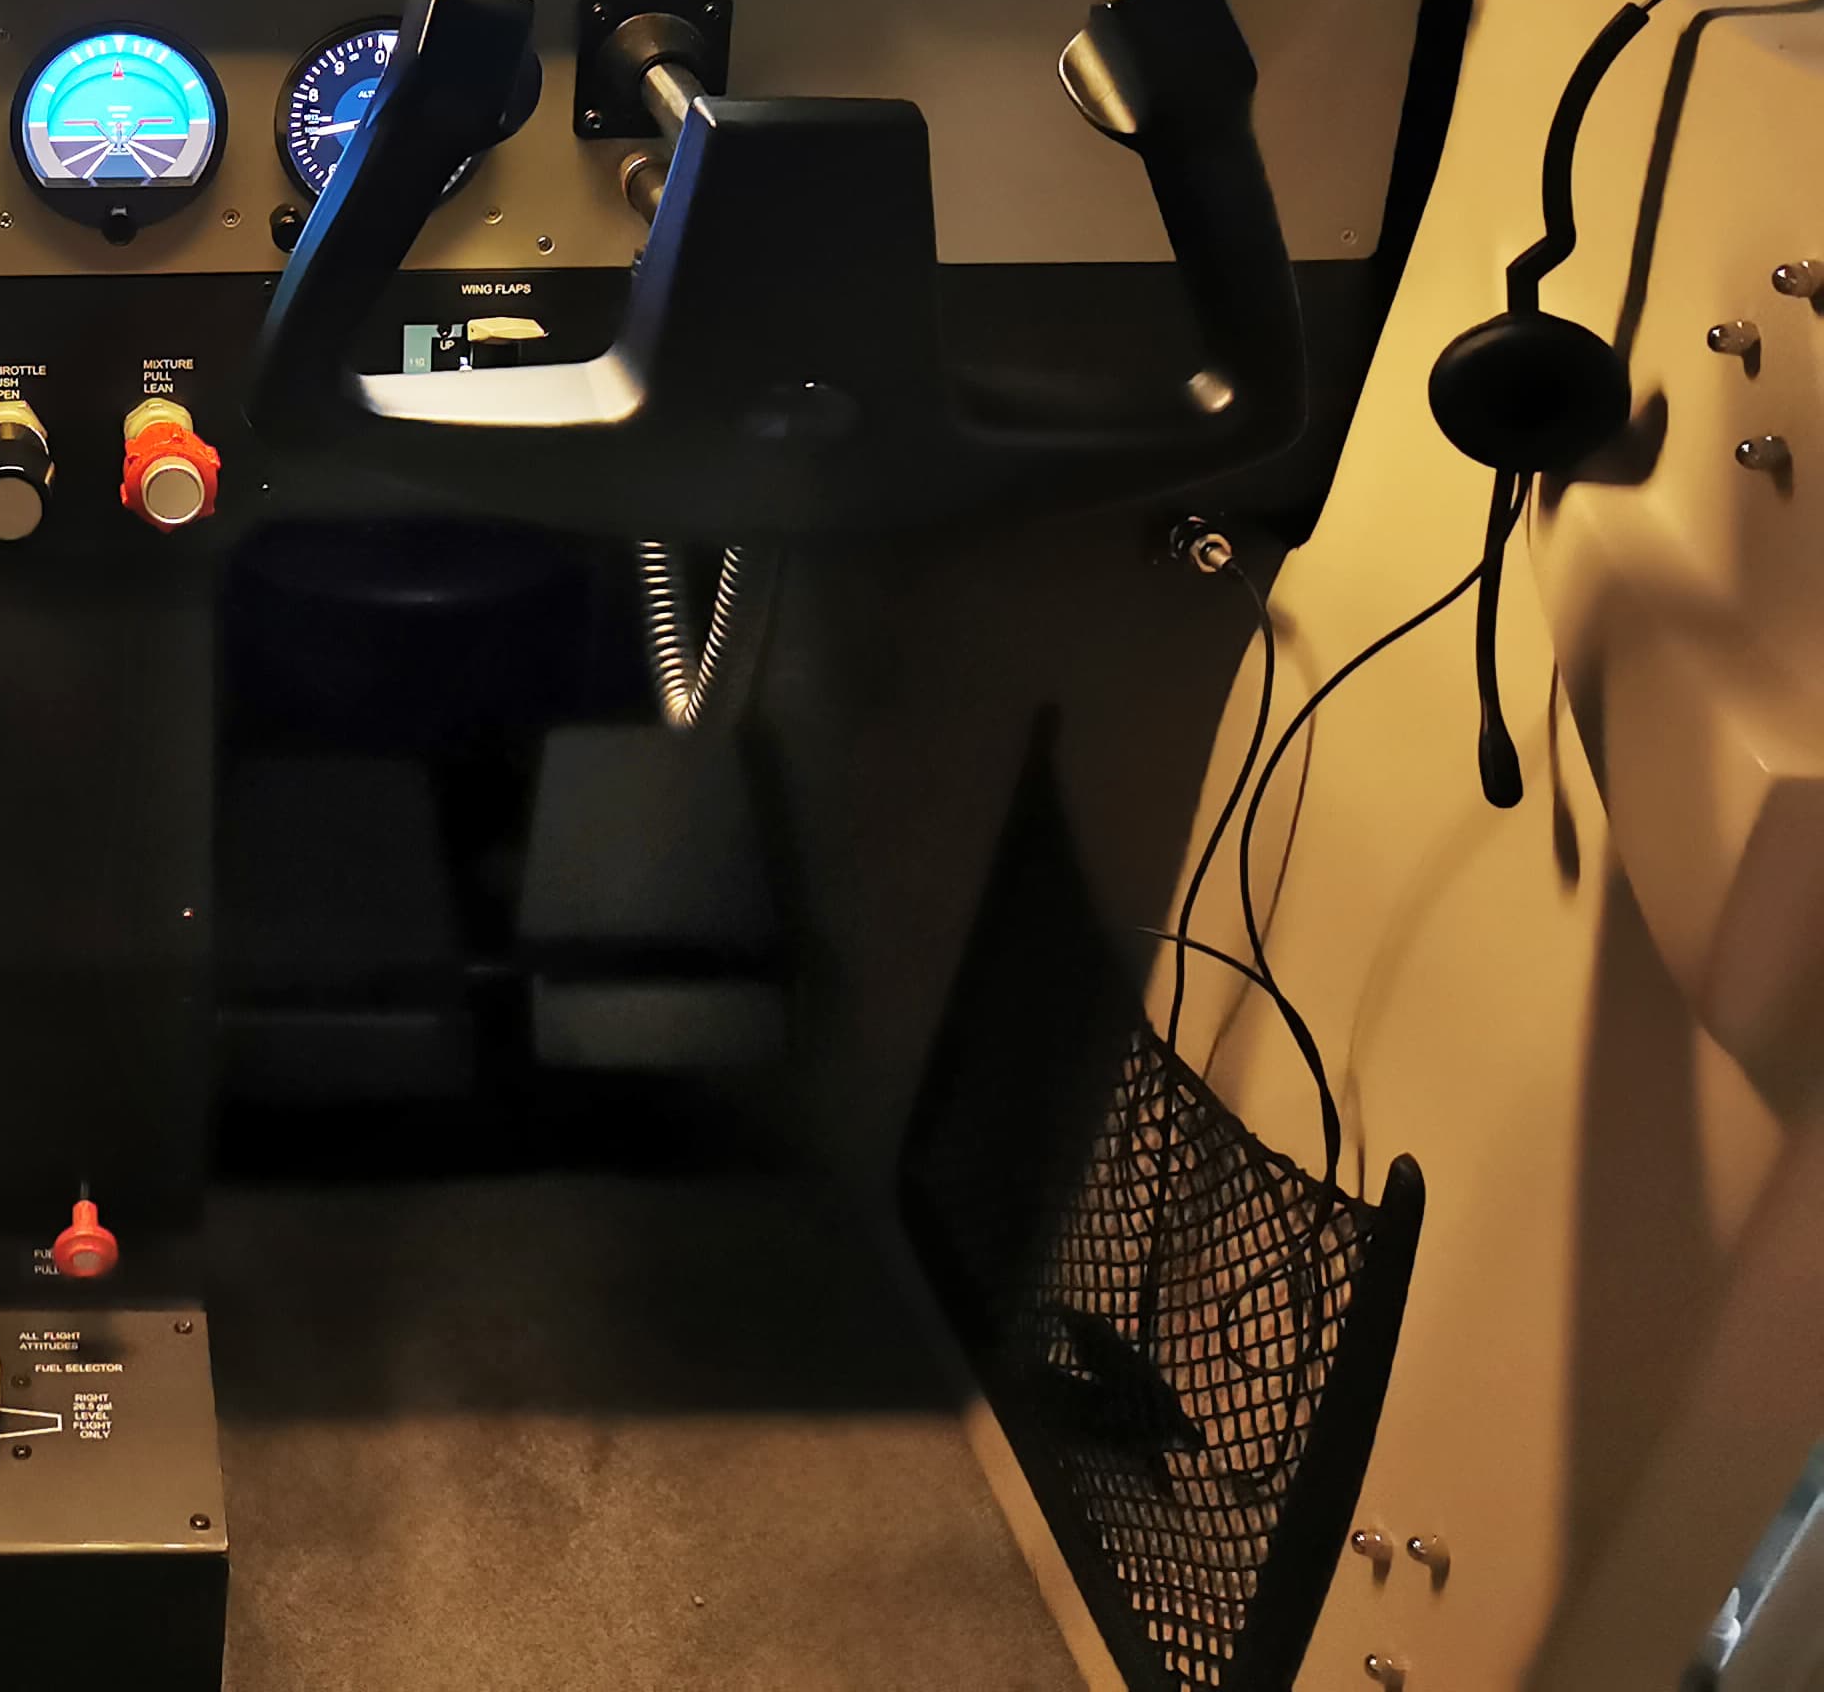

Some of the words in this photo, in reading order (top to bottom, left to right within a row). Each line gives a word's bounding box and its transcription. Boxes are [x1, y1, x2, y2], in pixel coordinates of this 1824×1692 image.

[374, 51, 385, 63] 0
[335, 61, 345, 75] 9
[309, 88, 319, 102] 8
[310, 136, 320, 150] 7
[462, 285, 492, 294] WING
[495, 284, 531, 294] FLAPS
[440, 341, 455, 350] UP
[144, 360, 194, 370] MIXTURE
[144, 372, 172, 382] PULL
[144, 384, 174, 394] LEAN
[35, 1364, 62, 1372] FUEL
[65, 1364, 123, 1372] SELECTOR
[75, 1394, 109, 1402] RIGHT
[97, 1402, 112, 1411] gal
[73, 1421, 112, 1429] FLIGHT
[80, 1430, 111, 1438] ONLY
